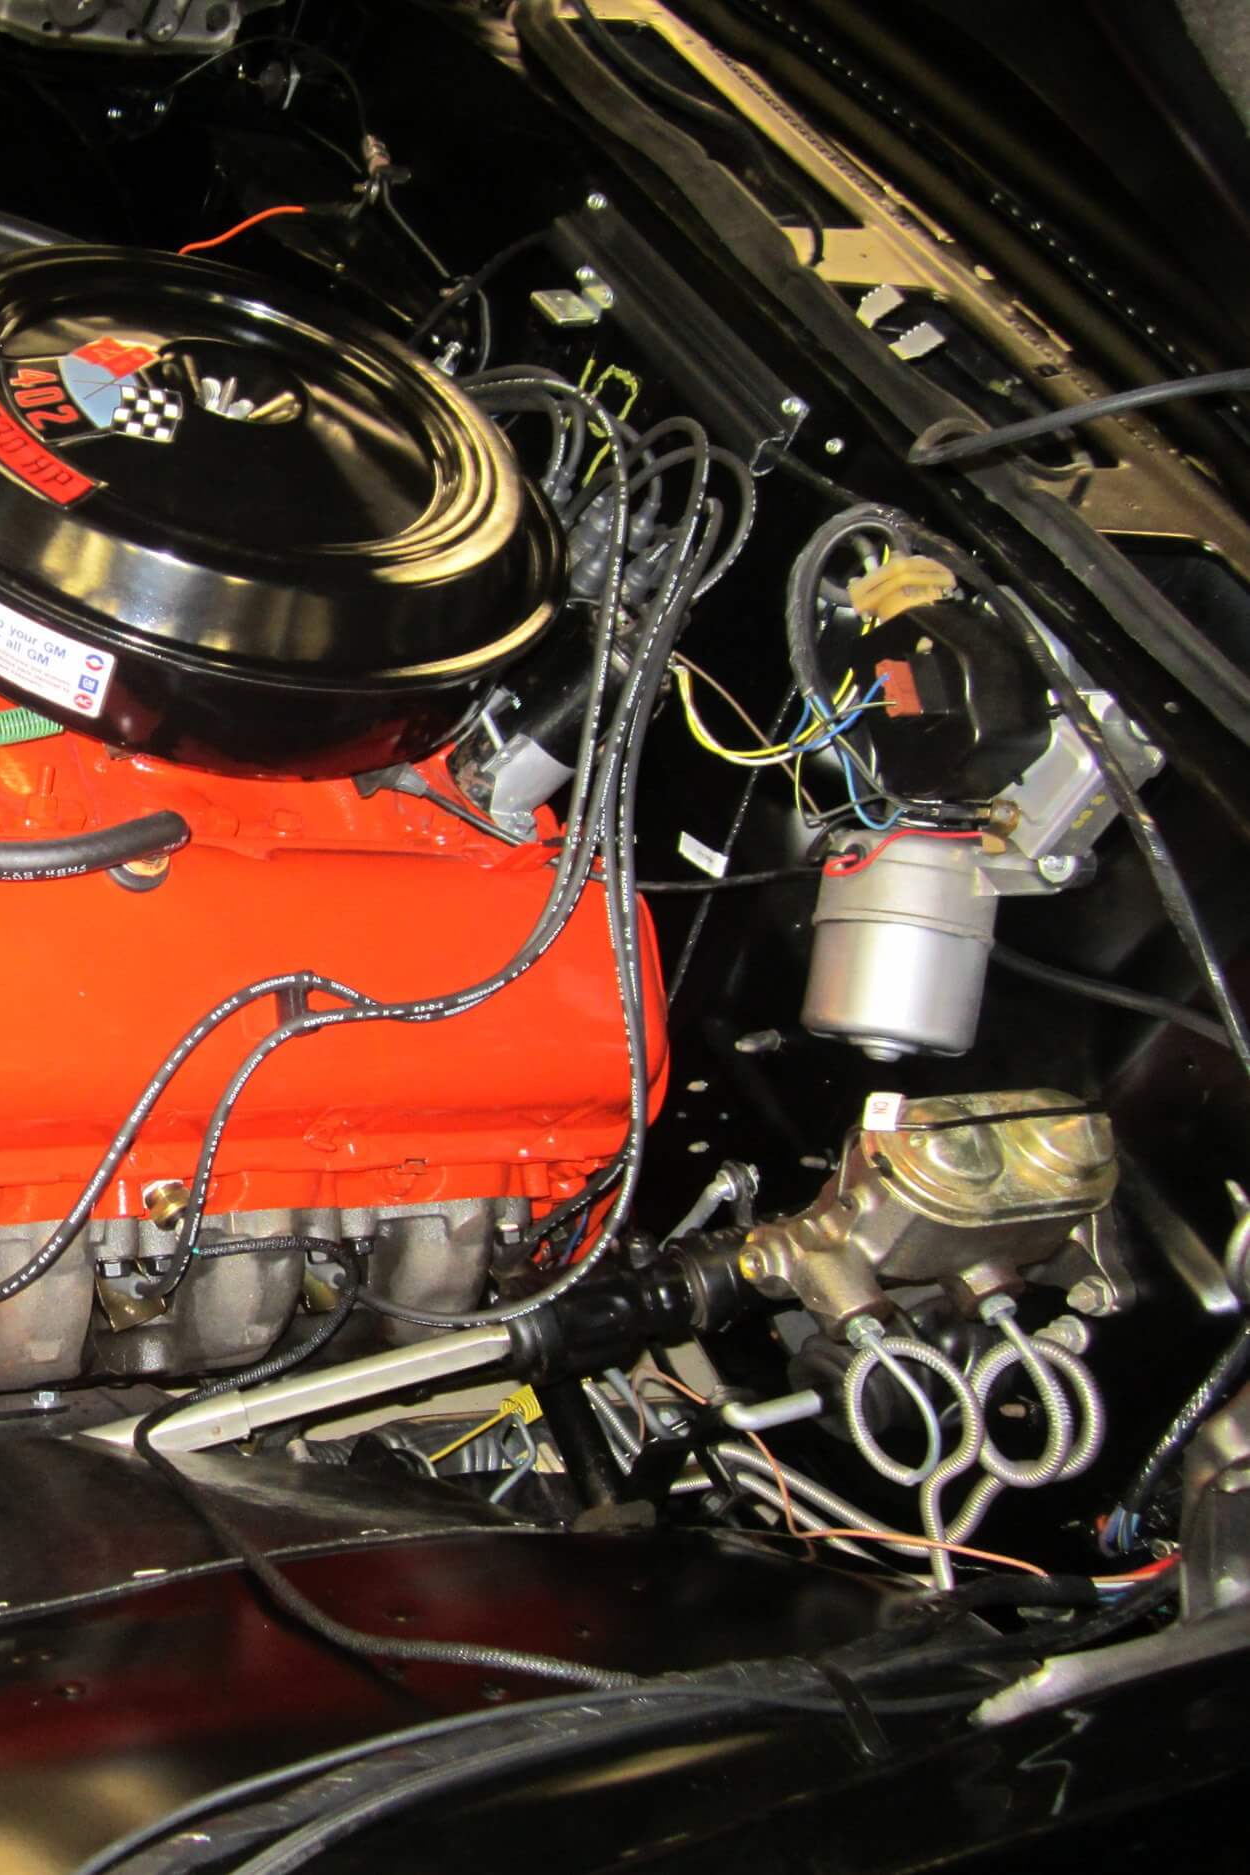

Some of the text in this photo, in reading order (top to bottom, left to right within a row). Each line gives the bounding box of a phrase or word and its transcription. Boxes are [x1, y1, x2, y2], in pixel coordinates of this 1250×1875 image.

[8, 368, 81, 431] 402
[22, 456, 75, 487] HP
[5, 638, 22, 653] all
[26, 648, 50, 666] GM
[9, 625, 38, 645] your
[43, 641, 67, 660] GM
[597, 650, 609, 692] PACKARD
[621, 870, 630, 913] PACKARD
[249, 975, 296, 994] SUPPRESSION
[311, 975, 323, 984] TV
[330, 980, 360, 999] PACKARD
[279, 1029, 292, 1041] TV
[303, 1013, 345, 1028] PACKARD
[226, 1053, 264, 1106] SUPPRESSION
[129, 1080, 160, 1123] PACKARD
[631, 1077, 639, 1120] PACKARD
[114, 1134, 127, 1150] TV
[68, 1168, 106, 1225] SUPPRESSION
